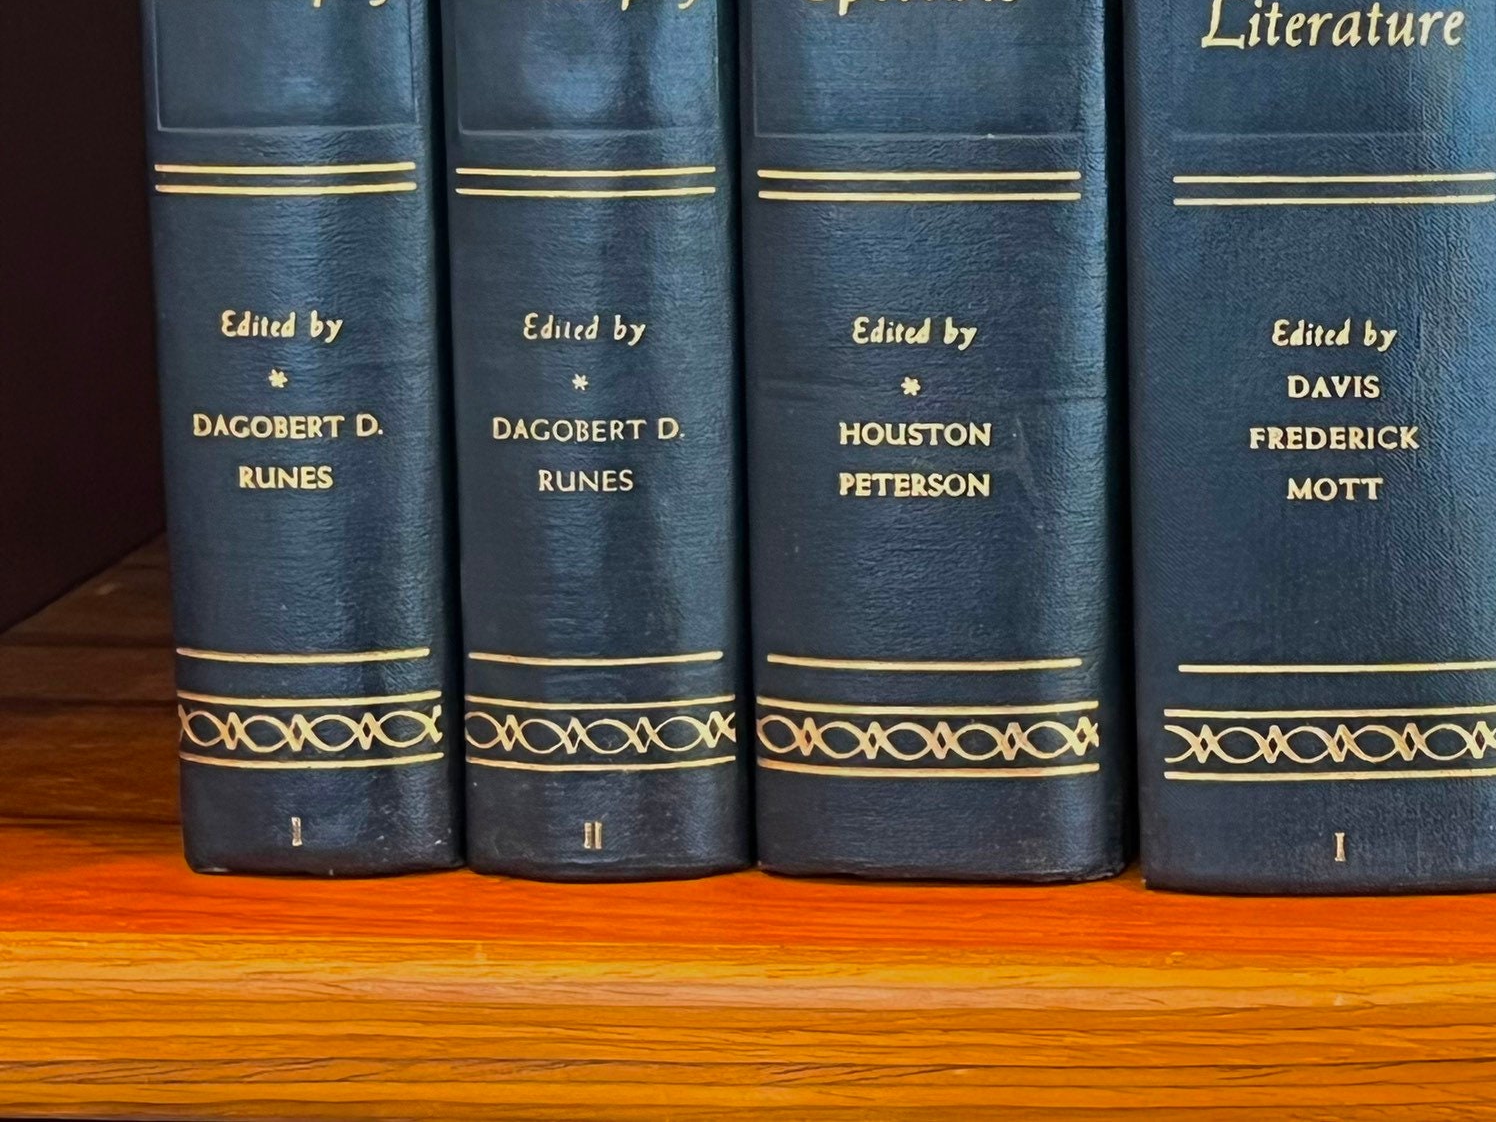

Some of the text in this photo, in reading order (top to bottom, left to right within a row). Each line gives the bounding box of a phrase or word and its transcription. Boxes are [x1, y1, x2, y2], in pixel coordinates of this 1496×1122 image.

[220, 309, 344, 344] Edited by
[523, 312, 647, 346] Edited by
[851, 316, 977, 350] Edited by
[1272, 318, 1396, 352] Edited by
[1287, 374, 1380, 399] DAVIS
[192, 412, 384, 440] DAGOBERT D.
[492, 416, 686, 442] DAGOBERT D.
[839, 421, 992, 447] HOUSTON
[1250, 425, 1418, 451] FREDERICK
[238, 465, 334, 490] RUNES
[538, 469, 634, 492] RUNES
[838, 472, 991, 498] PETERSON
[1287, 477, 1384, 502] MOTT
